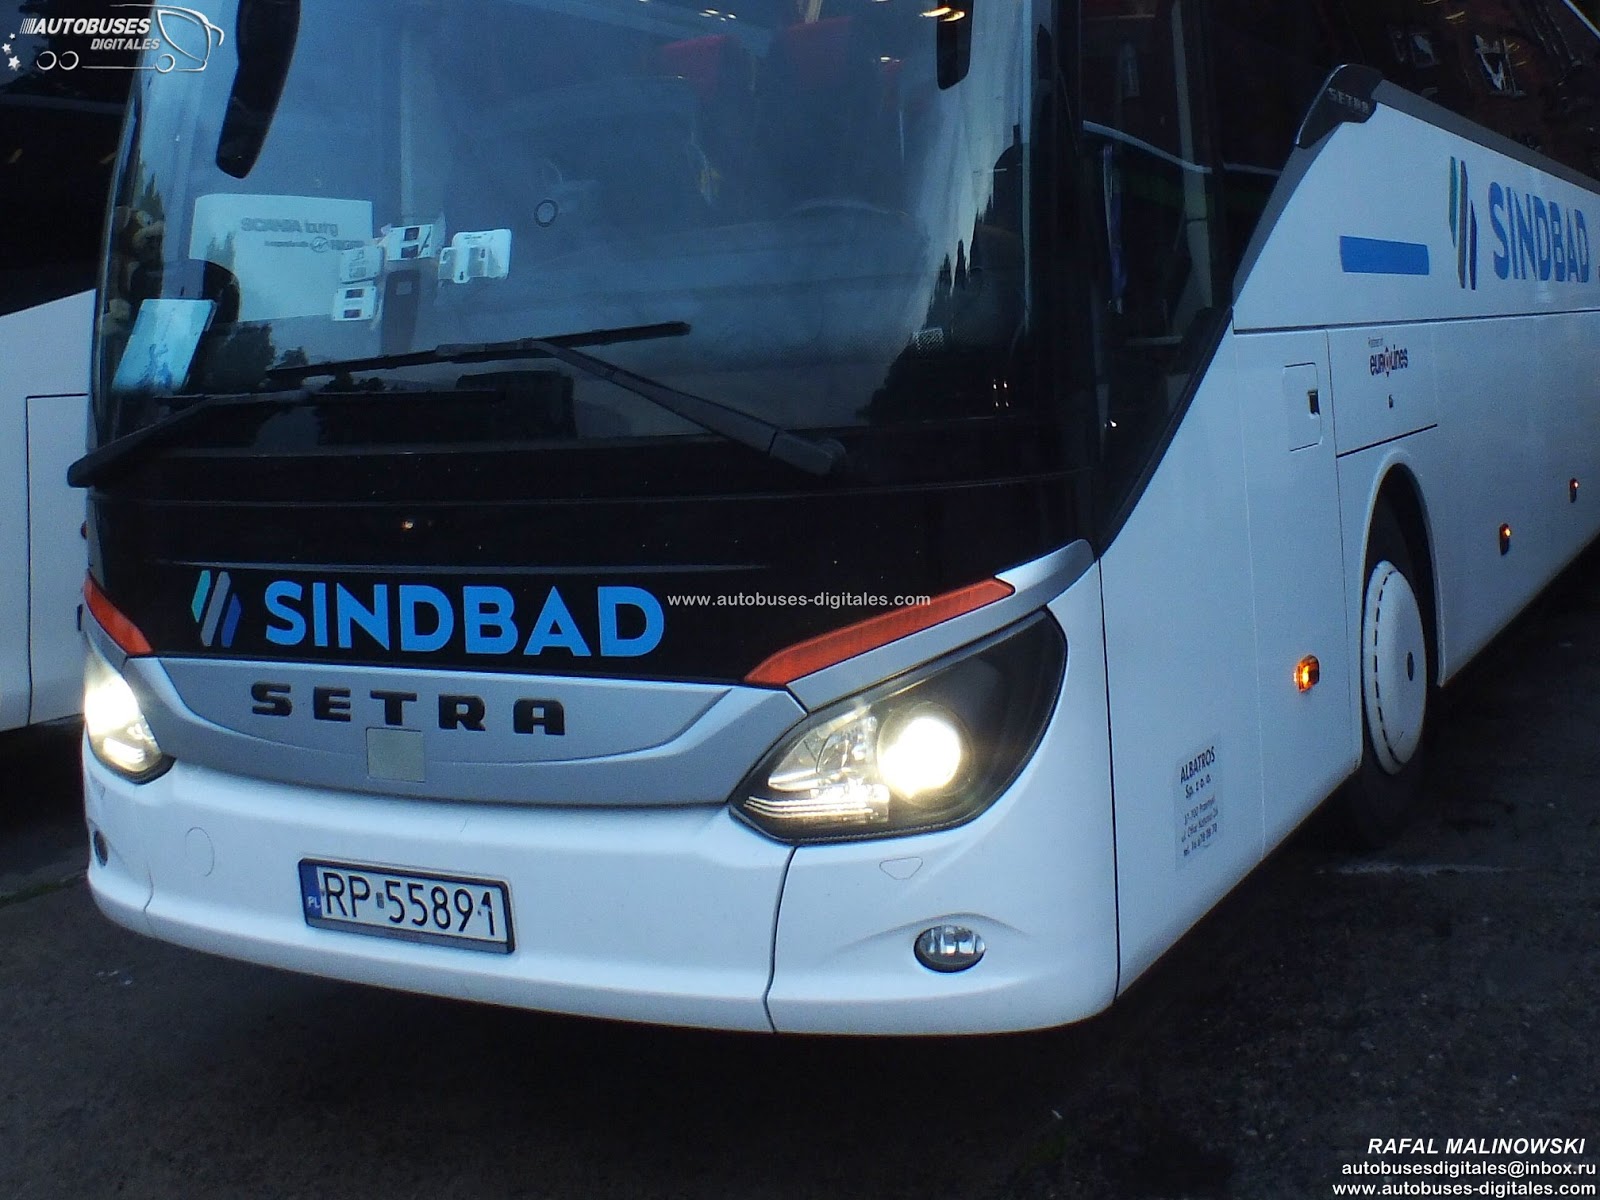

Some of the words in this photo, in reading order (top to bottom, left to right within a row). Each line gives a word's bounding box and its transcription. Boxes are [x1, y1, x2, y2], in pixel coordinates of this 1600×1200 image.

[1488, 181, 1590, 283] SINDBAD
[264, 580, 665, 657] SINDBAD
[251, 681, 565, 736] SETRA
[1180, 745, 1216, 785] ALBATROS
[307, 895, 321, 909] PL
[322, 872, 371, 918] RP
[385, 879, 495, 936] 55891
